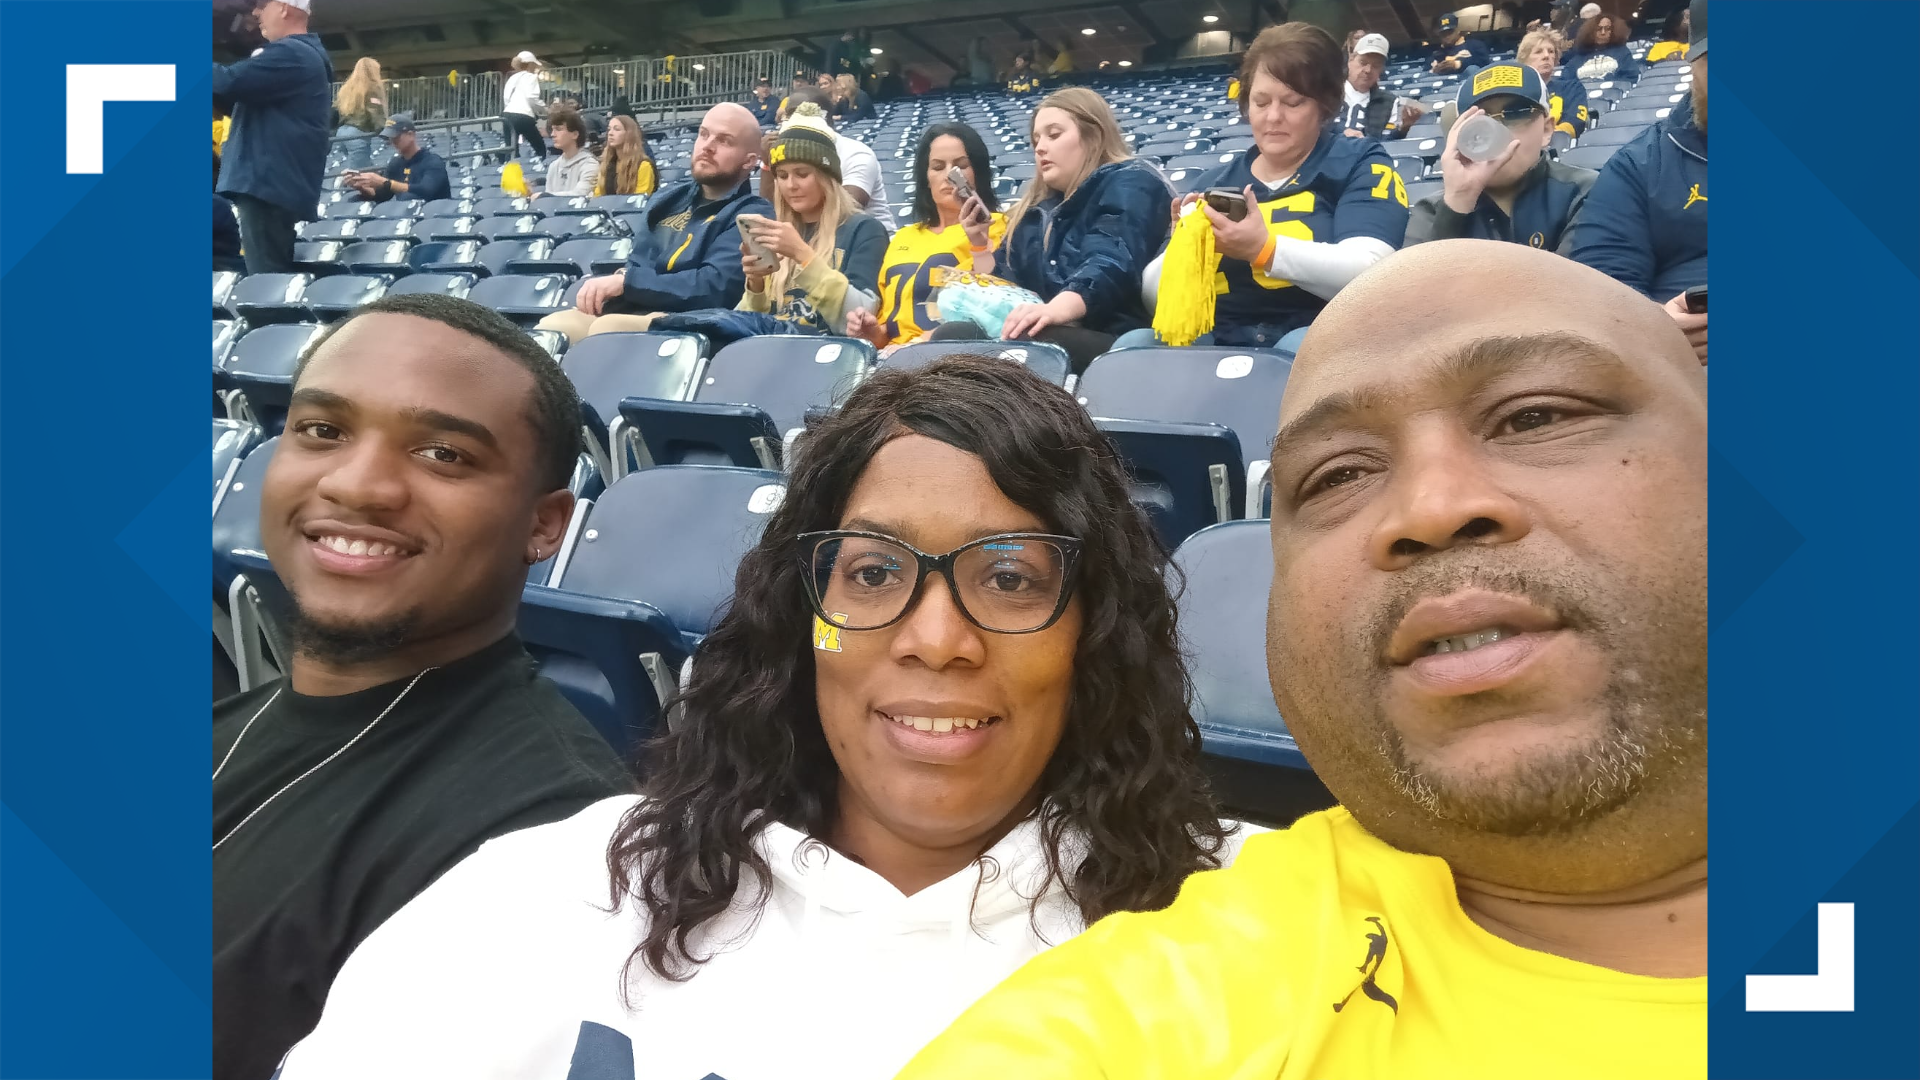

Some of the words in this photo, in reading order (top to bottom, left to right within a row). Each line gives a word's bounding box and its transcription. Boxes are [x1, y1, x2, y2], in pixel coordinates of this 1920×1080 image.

[769, 144, 786, 165] M
[1371, 163, 1409, 208] 76
[814, 612, 849, 653] M
